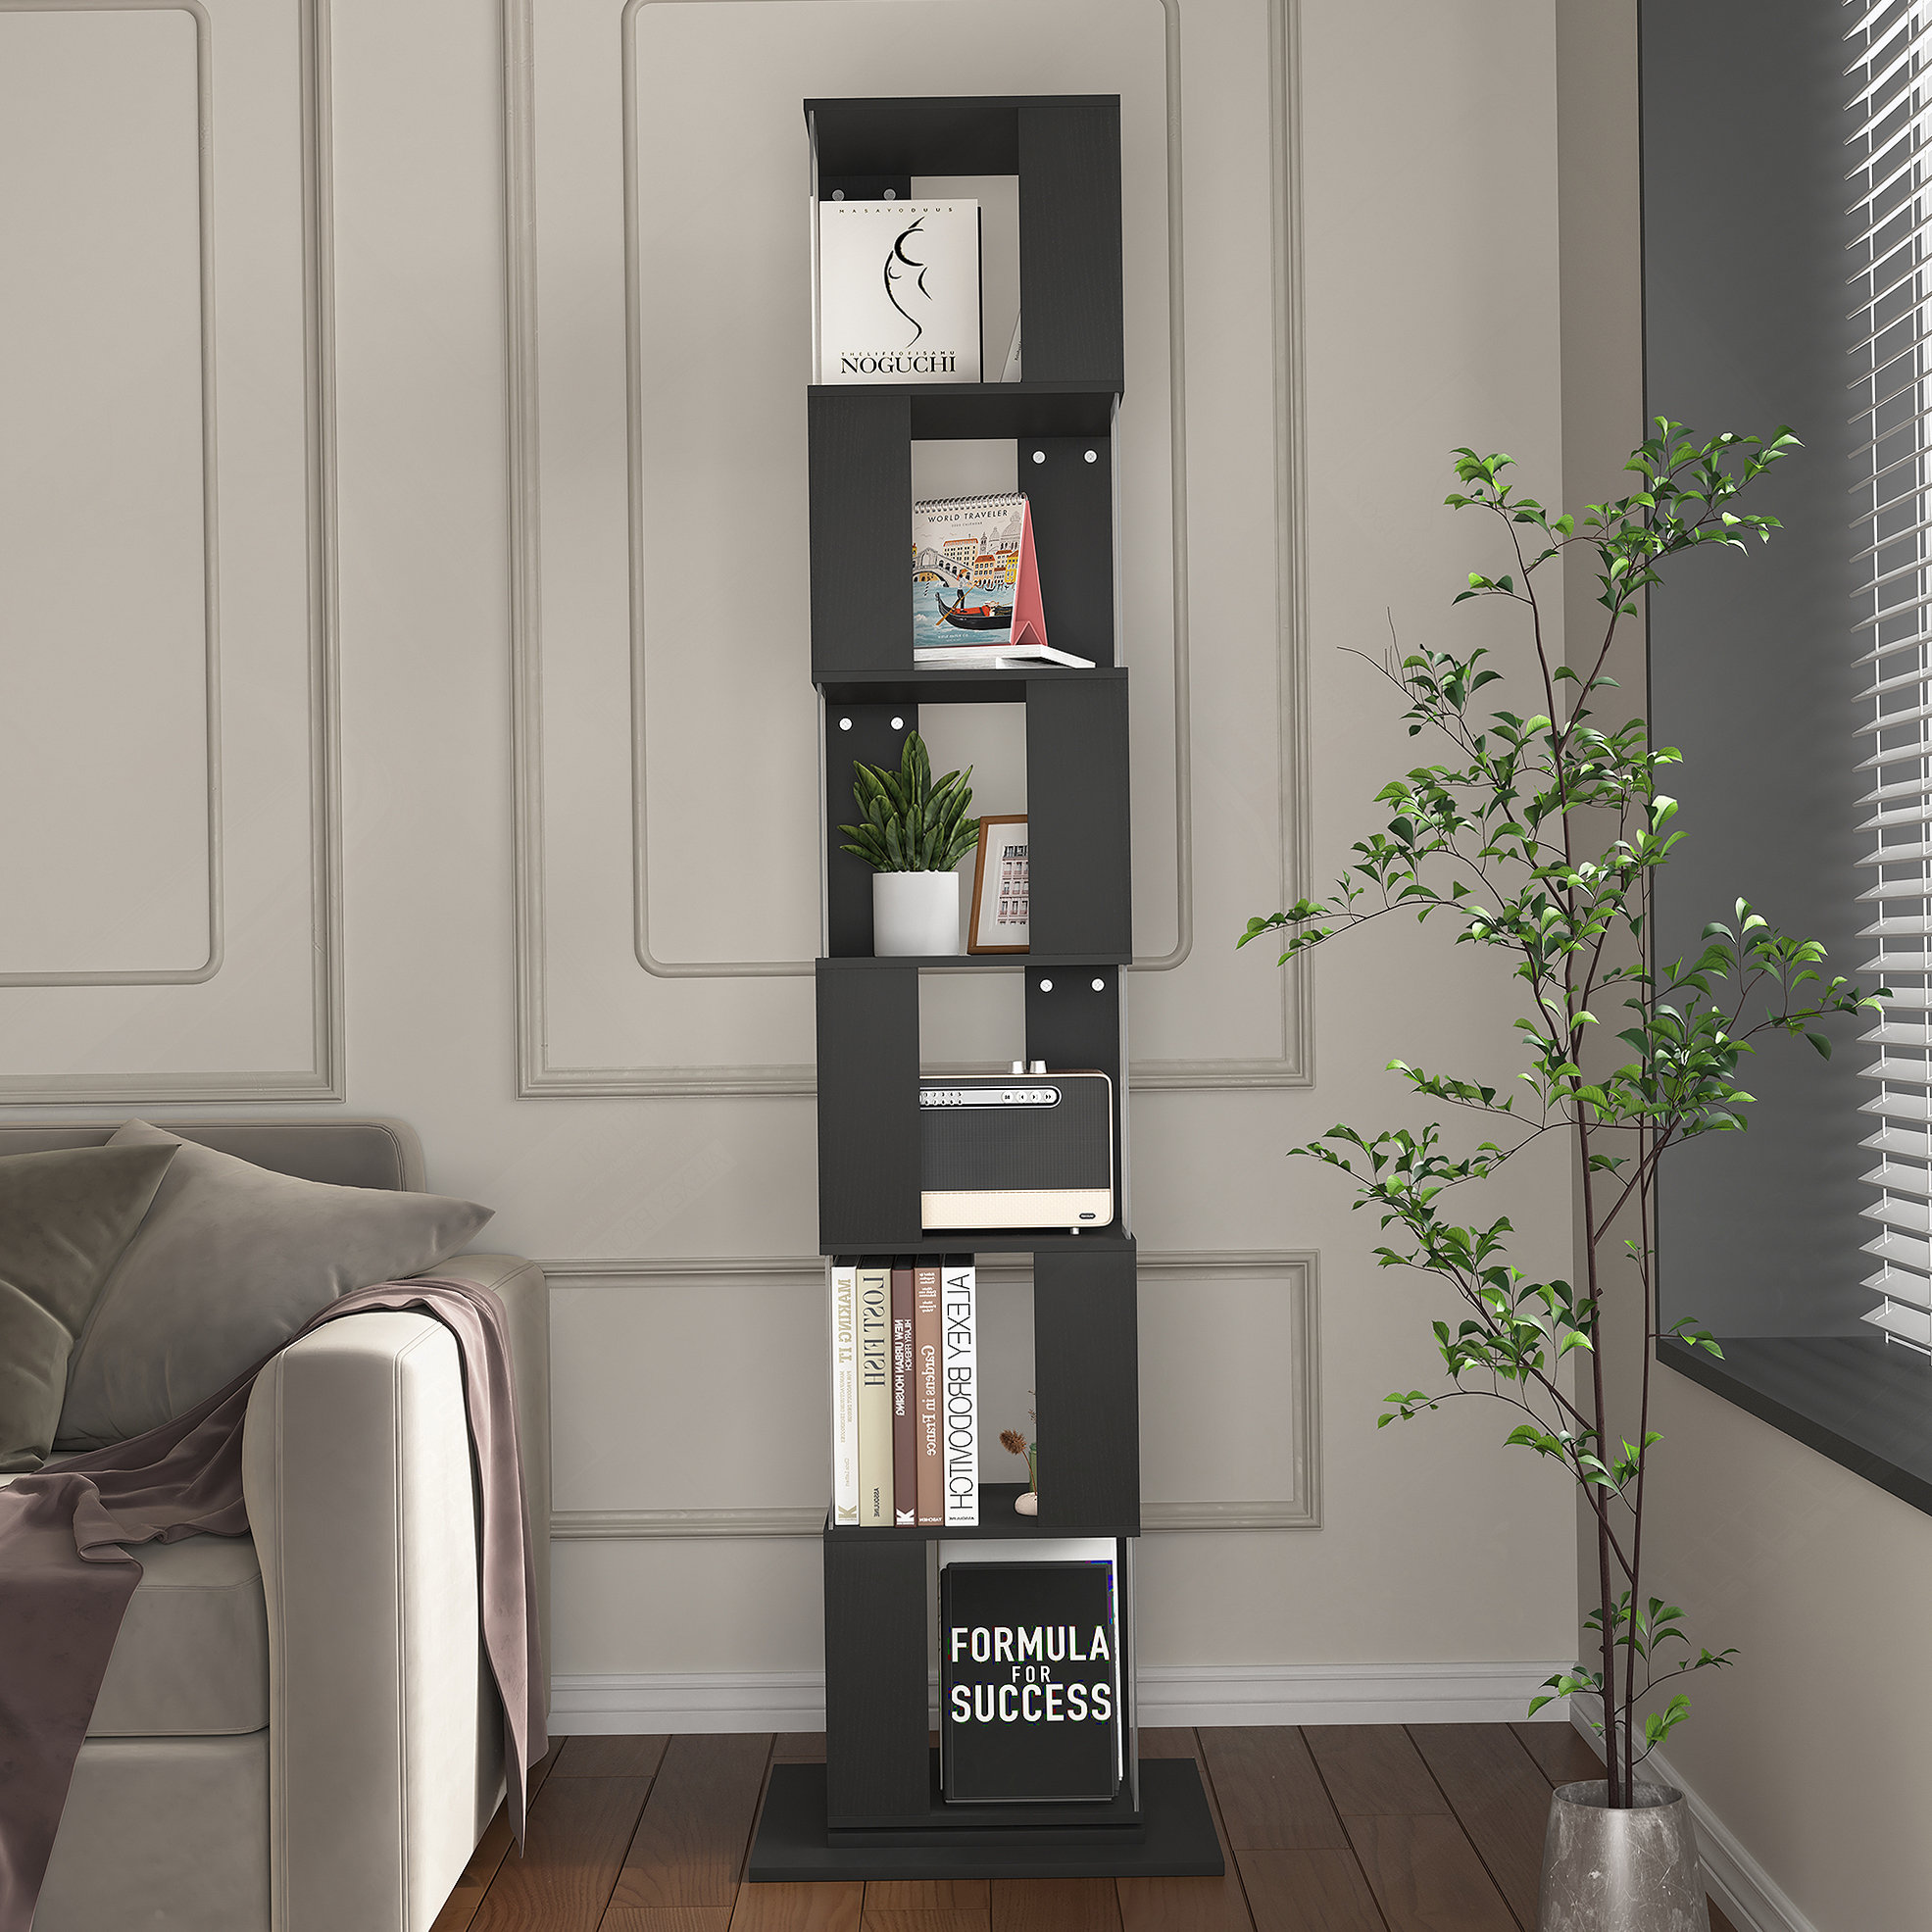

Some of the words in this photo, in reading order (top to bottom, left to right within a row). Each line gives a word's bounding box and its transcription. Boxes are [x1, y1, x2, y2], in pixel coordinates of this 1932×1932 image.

[841, 356, 956, 374] NOGUCHI
[927, 514, 961, 523] WORLD
[965, 509, 1008, 520] TRAVELER
[951, 1625, 1110, 1662] FORMULA
[1012, 1665, 1051, 1683] FOR
[951, 1682, 1112, 1723] SUCCESS
